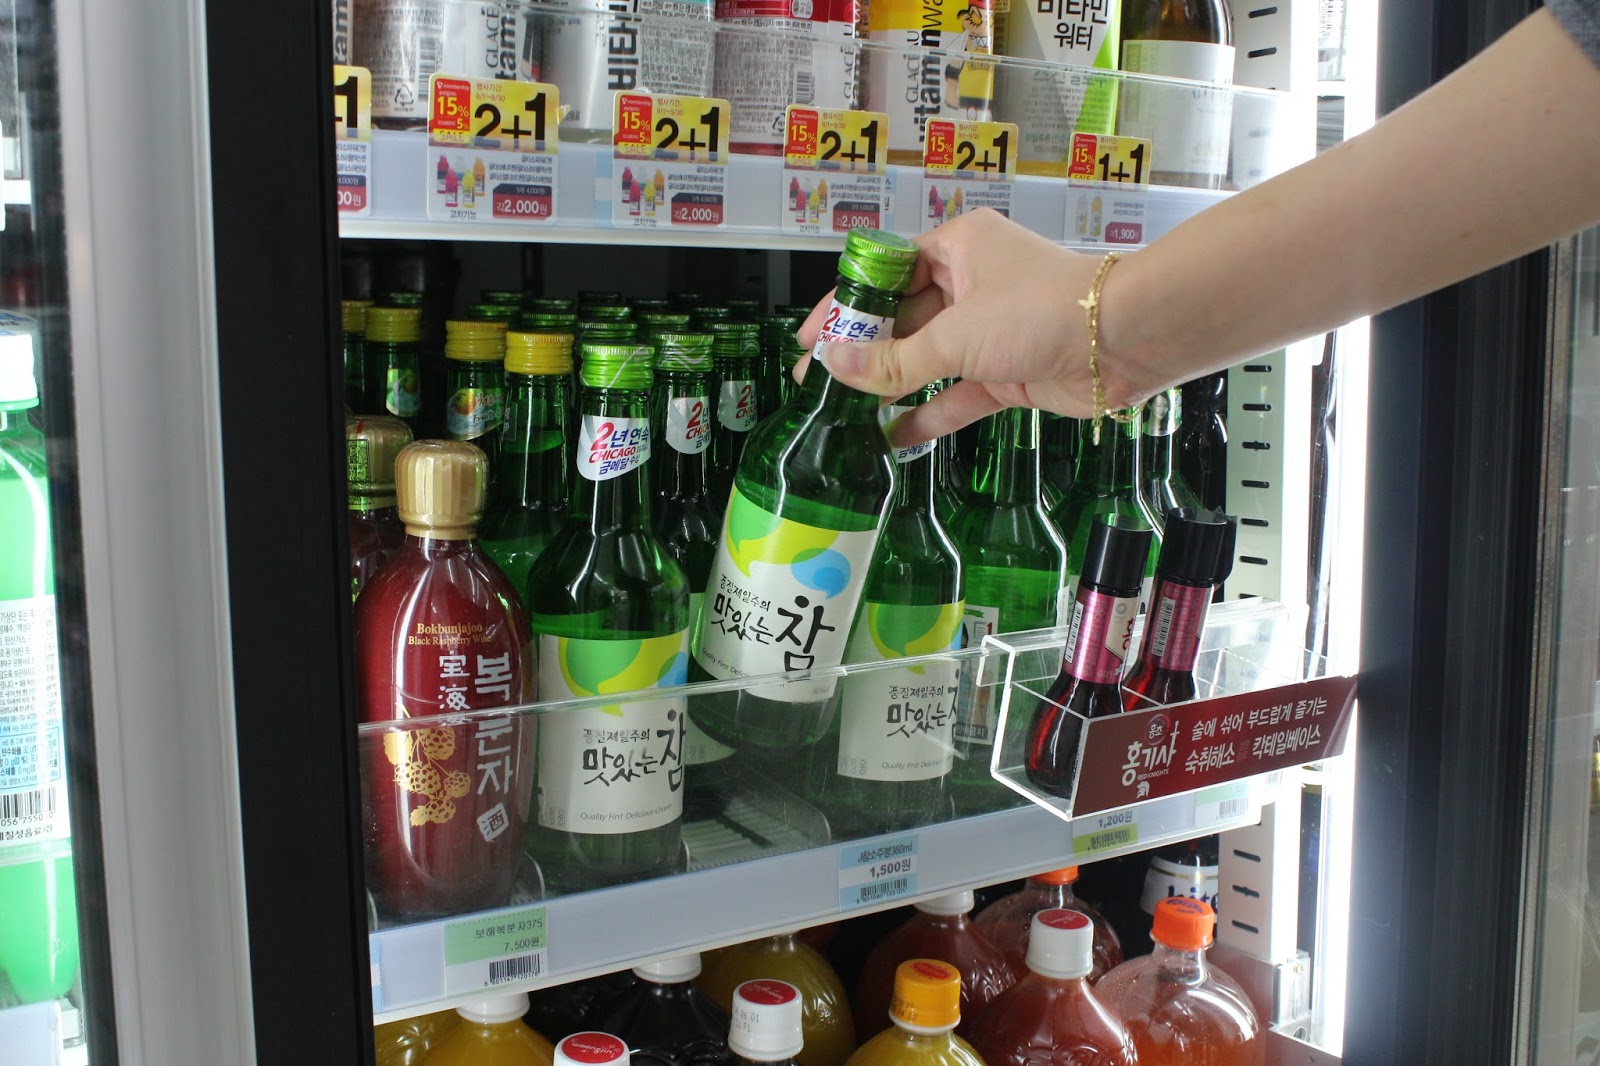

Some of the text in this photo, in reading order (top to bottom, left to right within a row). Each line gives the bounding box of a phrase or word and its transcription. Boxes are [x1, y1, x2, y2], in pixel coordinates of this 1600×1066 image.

[607, 0, 642, 91] 비타
[1054, 22, 1093, 51] 워터
[437, 96, 469, 117] 15%
[474, 92, 546, 151] 2+1
[622, 111, 650, 131] 15%
[440, 131, 464, 141] SALE
[655, 107, 720, 161] 2+1
[791, 125, 816, 143] 15%
[624, 144, 646, 154] SALE
[820, 120, 878, 172] 2+1
[930, 136, 952, 153] 15%
[956, 131, 1008, 179] 2+1
[1075, 148, 1094, 163] 15%
[1099, 144, 1144, 189] 1+1
[822, 307, 880, 339] 2년 연속
[591, 422, 649, 452] 2년 연속
[589, 446, 636, 464] CHICAGO
[599, 457, 630, 475] 금메달
[416, 622, 483, 636] Bokbunjajoo
[711, 593, 836, 683] 맛있는 참
[408, 635, 431, 645] Black
[433, 634, 471, 648] Raspberry
[888, 685, 945, 700] 품질제일주의
[886, 702, 948, 739] 맛있는
[1191, 696, 1328, 741] 술에 섞어 부드럽게 즐기는
[1148, 723, 1163, 740] 홍초
[583, 708, 687, 792] 맛있는 참
[1121, 720, 1180, 787] 홍기사
[1184, 742, 1236, 775] 숙취해소
[1252, 724, 1322, 760] 칵테일베이스
[1137, 768, 1170, 781] RED KNIGHTS
[22, 813, 43, 825] 7550
[580, 812, 606, 821] Quality
[625, 809, 654, 819] Delicious
[1098, 810, 1133, 828] 1,200원
[869, 858, 911, 878] 1,500원
[475, 918, 543, 938] 보해복분자375
[504, 936, 540, 951] 7,500원
